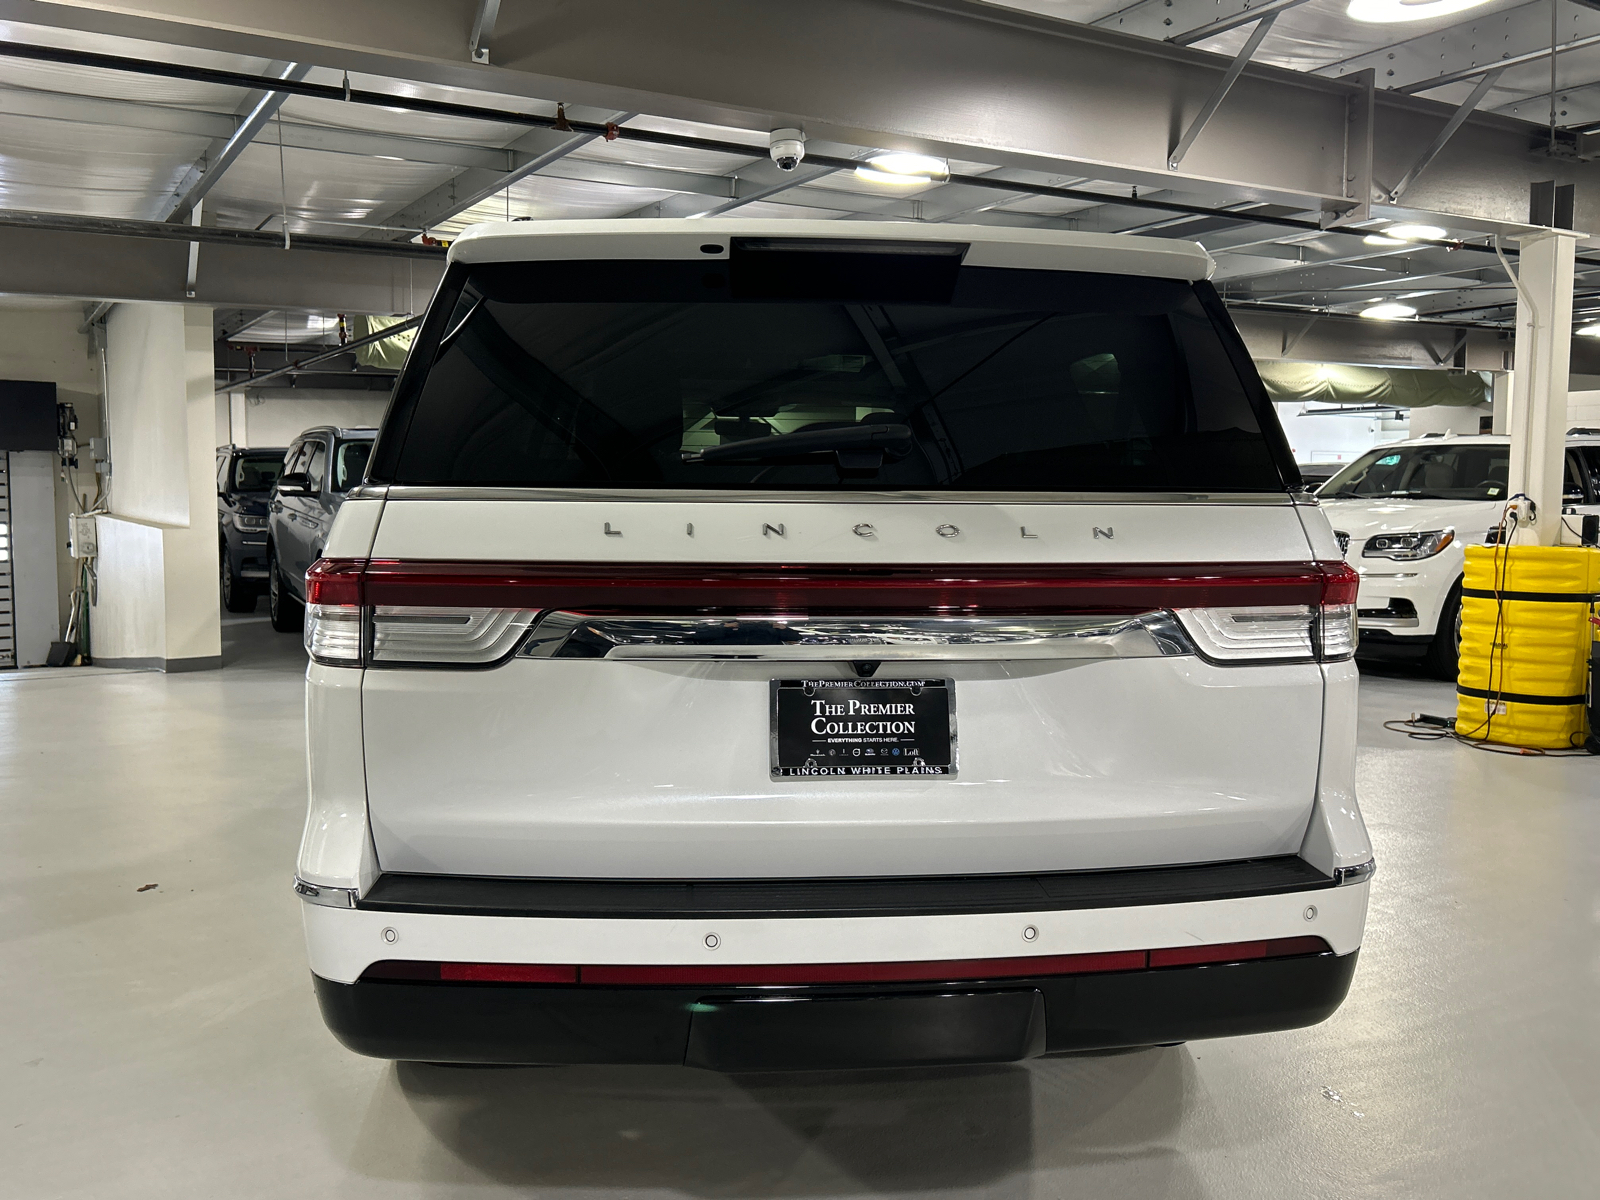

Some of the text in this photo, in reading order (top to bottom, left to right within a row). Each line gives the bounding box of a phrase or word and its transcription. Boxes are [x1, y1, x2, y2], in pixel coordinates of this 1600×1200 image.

[603, 521, 1115, 540] LINCOLN
[811, 717, 916, 735] COLLECTION
[789, 766, 943, 776] LINCOLN WHITE PLAINS
